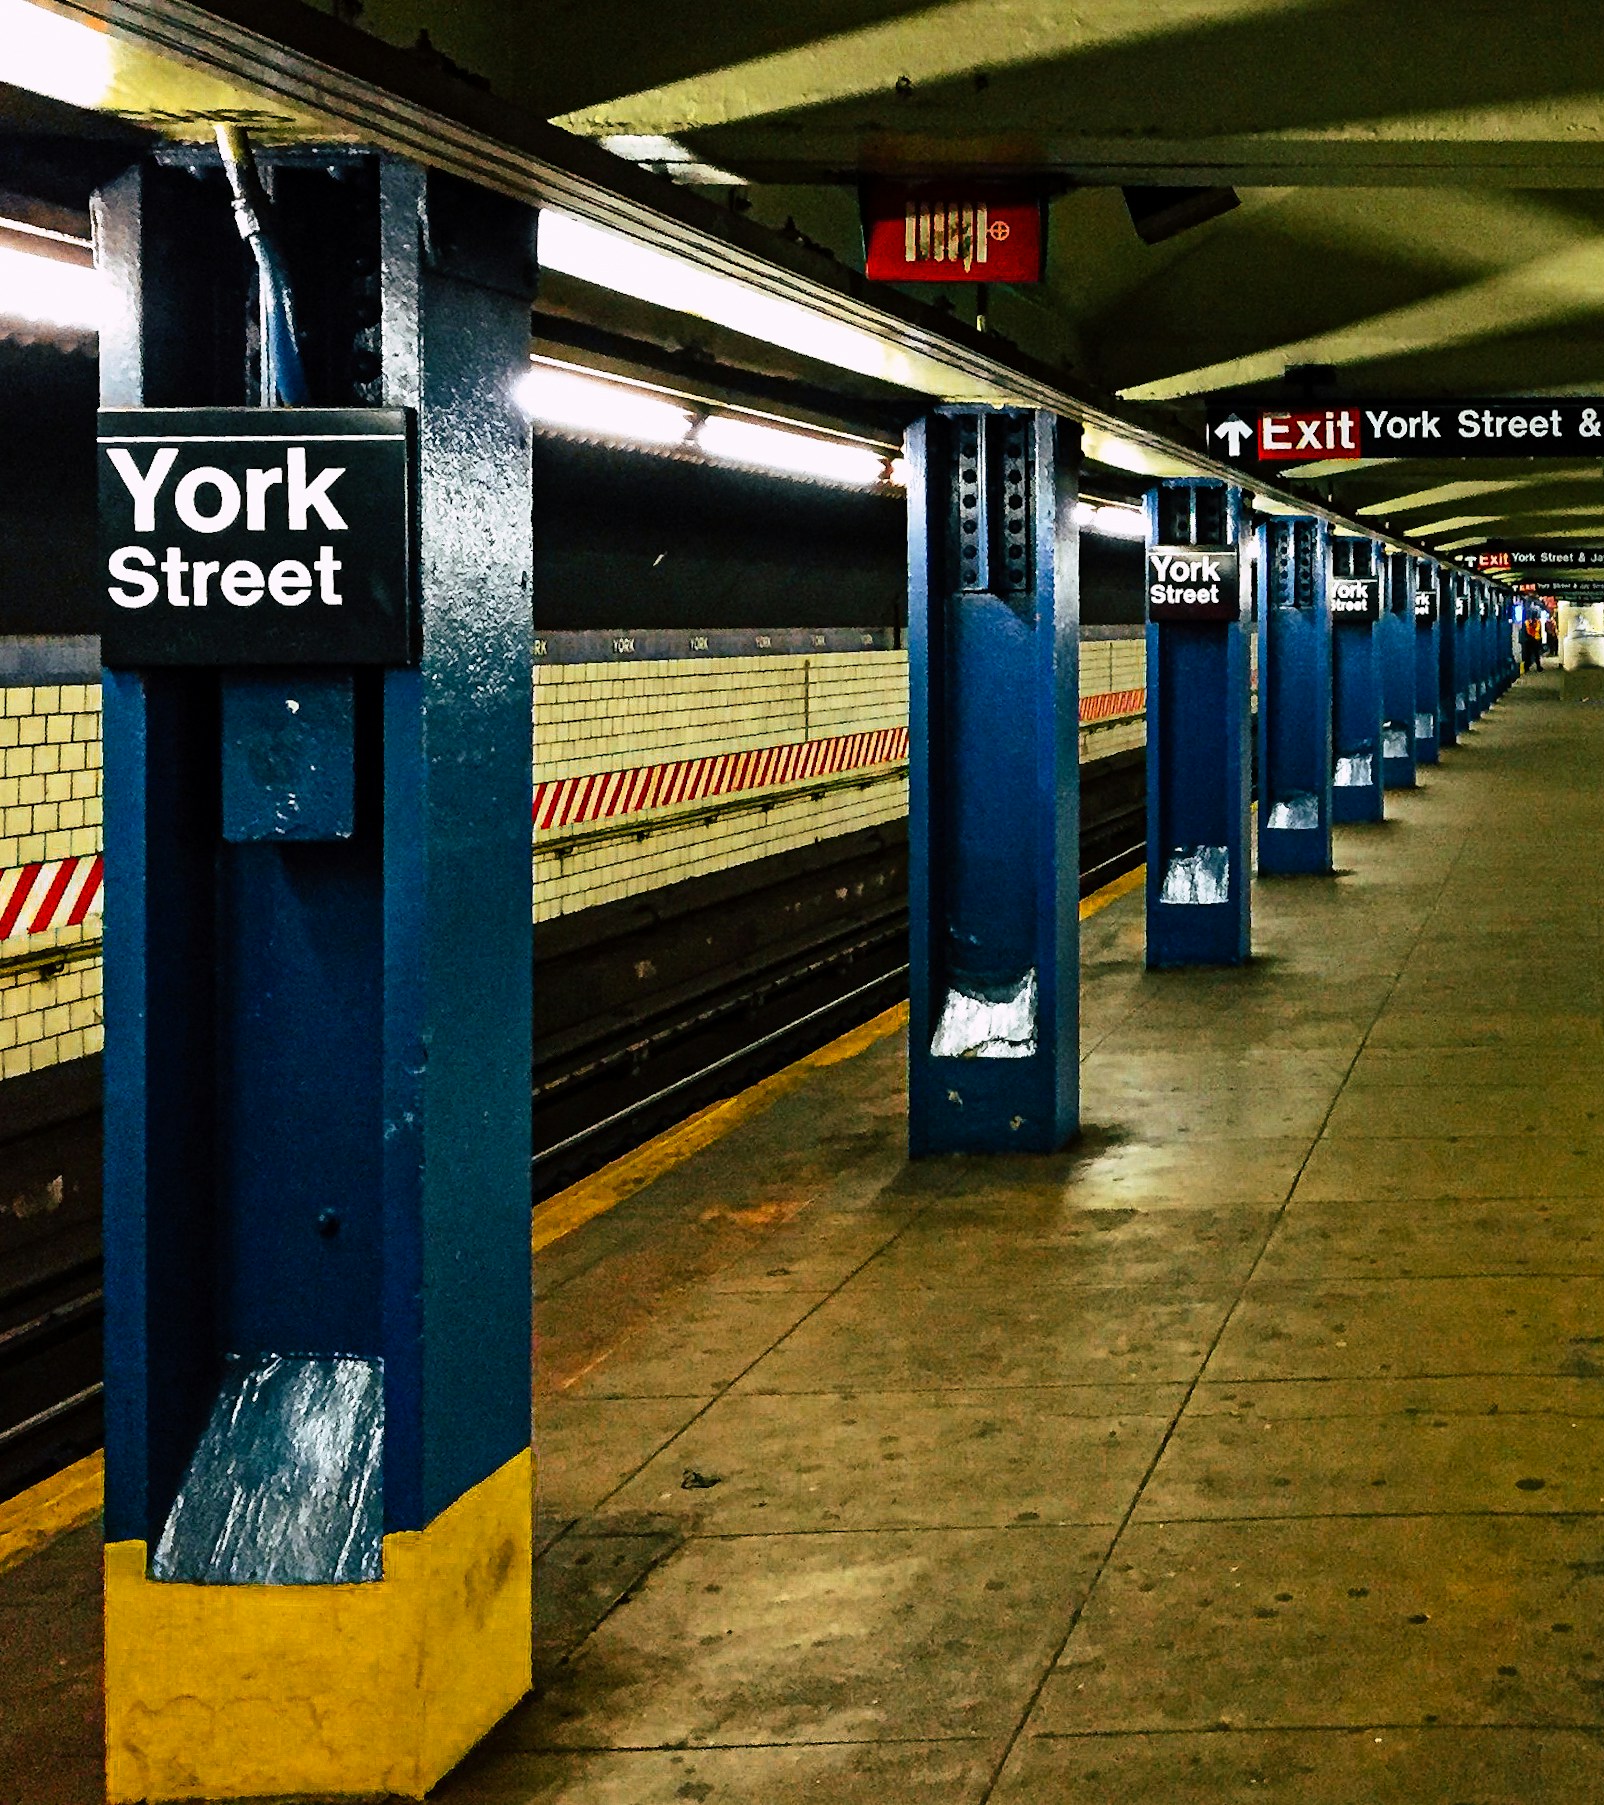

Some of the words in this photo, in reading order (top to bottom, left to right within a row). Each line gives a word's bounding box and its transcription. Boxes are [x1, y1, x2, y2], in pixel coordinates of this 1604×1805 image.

[1262, 411, 1356, 450] Exit
[1365, 410, 1442, 439] York
[1458, 409, 1563, 439] Street
[1578, 407, 1602, 438] &
[106, 446, 349, 534] York
[1149, 555, 1221, 582] York
[1478, 552, 1510, 566] Exit
[1511, 552, 1536, 563] York
[1540, 551, 1574, 563] Street
[1577, 551, 1586, 562] &
[107, 545, 343, 609] Street
[1149, 584, 1220, 604] Street
[533, 639, 548, 656] RK
[613, 637, 636, 654] YORK
